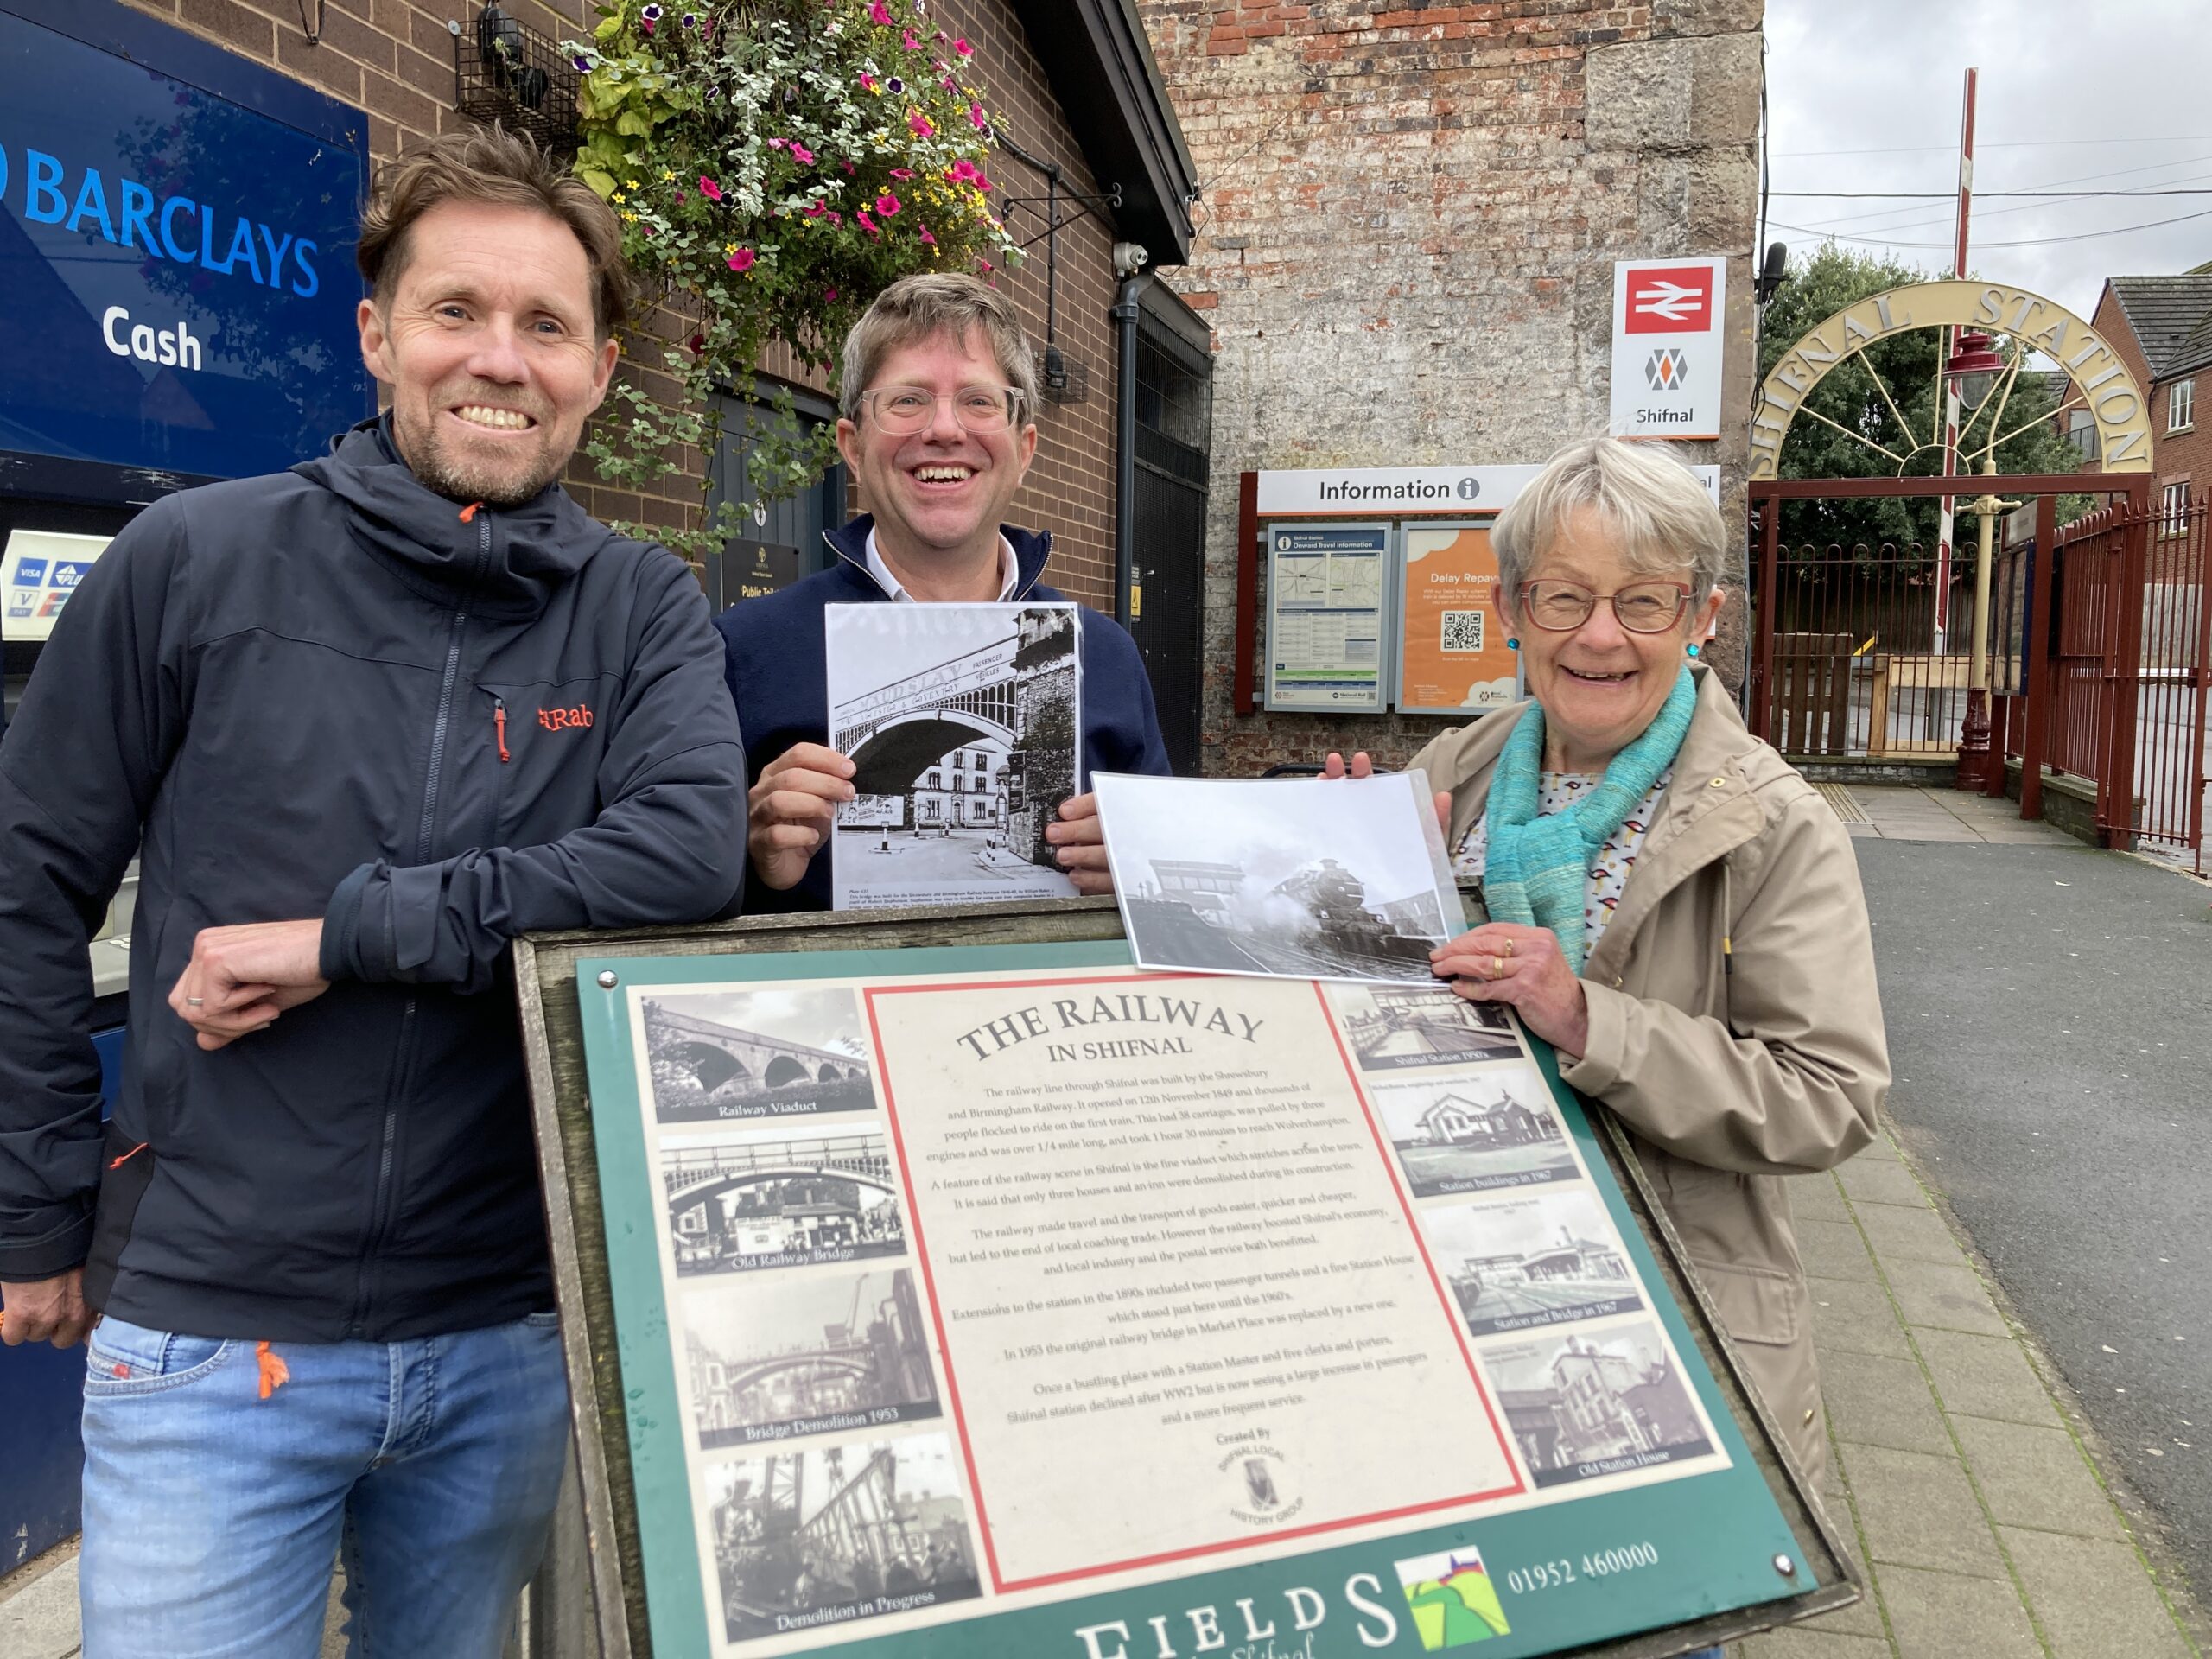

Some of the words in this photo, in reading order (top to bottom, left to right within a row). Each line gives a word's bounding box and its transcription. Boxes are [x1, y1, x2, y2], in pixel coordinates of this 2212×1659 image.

[25, 149, 319, 297] BARCLAYS
[103, 306, 201, 371] Cash
[1749, 295, 1912, 478] SHIFNAL
[1974, 289, 2149, 465] STATION
[1637, 408, 1694, 423] Shifnal
[1319, 480, 1450, 499] Information
[21, 569, 41, 578] VISA
[61, 575, 84, 585] PLU
[1430, 573, 1460, 584] Delay
[741, 585, 761, 597] Public
[973, 653, 1003, 669] PASSENGER
[860, 663, 963, 711] MAUDSLAY
[547, 704, 594, 731] Rab
[957, 1007, 1050, 1061] THE
[1051, 995, 1264, 1043] RAILWAY
[1046, 1043, 1077, 1062] IN
[1084, 1037, 1193, 1060] SHIFNAL
[1395, 1054, 1428, 1066] Shifnal
[1428, 1052, 1461, 1064] Station
[982, 1087, 1003, 1097] The
[1005, 1085, 1041, 1096] railway
[1043, 1084, 1063, 1093] line
[1064, 1080, 1103, 1092] through
[1103, 1077, 1139, 1089] Shifnal
[1160, 1074, 1183, 1084] built
[1183, 1073, 1196, 1084] by
[1198, 1071, 1213, 1082] the
[1213, 1069, 1268, 1080] Shrewsbury
[719, 1105, 767, 1116] Railway
[770, 1102, 817, 1113] Viaduct
[947, 1109, 967, 1120] and
[968, 1105, 1032, 1118] Birmingham
[1077, 1100, 1086, 1109] It
[1087, 1096, 1123, 1111] opened
[1138, 1094, 1160, 1104] 12th
[1160, 1090, 1210, 1103] November
[1211, 1088, 1233, 1099] 1849
[1234, 1087, 1253, 1096] and
[1253, 1083, 1300, 1095] thousands
[1300, 1082, 1311, 1091] of
[944, 1128, 978, 1143] people
[980, 1123, 1018, 1137] flocked
[1019, 1125, 1031, 1134] to
[1032, 1122, 1052, 1132] ride
[1069, 1119, 1085, 1129] the
[1086, 1118, 1108, 1128] first
[1135, 1113, 1158, 1123] This
[1157, 1111, 1178, 1122] had
[1178, 1110, 1191, 1120] 38
[1256, 1102, 1287, 1116] pulled
[1286, 1102, 1300, 1113] by
[1300, 1100, 1325, 1109] three
[925, 1150, 966, 1164] engines
[968, 1147, 988, 1158] and
[989, 1147, 1011, 1155] was
[1012, 1145, 1034, 1154] over
[1037, 1141, 1056, 1154] 1/4
[1058, 1139, 1080, 1150] mile
[1109, 1135, 1128, 1146] and
[1128, 1133, 1151, 1144] took
[1152, 1132, 1158, 1141] 1
[1159, 1131, 1183, 1141] hour
[1184, 1128, 1197, 1138] 30
[1198, 1127, 1236, 1137] minutes
[1248, 1122, 1274, 1133] reach
[931, 1179, 940, 1191] A
[942, 1179, 980, 1190] feature
[981, 1174, 992, 1185] of
[995, 1173, 1011, 1184] the
[1014, 1171, 1052, 1183] railway
[1053, 1169, 1081, 1179] scene
[1083, 1166, 1095, 1176] in
[1095, 1162, 1131, 1174] Shifnal
[1132, 1162, 1141, 1172] is
[1142, 1160, 1159, 1170] the
[1160, 1158, 1179, 1168] fine
[1180, 1154, 1217, 1166] viaduct
[1217, 1151, 1249, 1162] which
[1249, 1147, 1290, 1160] stretches
[1319, 1143, 1335, 1153] the
[953, 1198, 963, 1209] It
[964, 1198, 975, 1208] is
[976, 1194, 998, 1206] said
[1000, 1193, 1020, 1205] that
[1022, 1191, 1046, 1204] only
[1047, 1189, 1074, 1199] three
[1075, 1186, 1111, 1197] houses
[1112, 1181, 1132, 1193] and
[1166, 1179, 1191, 1187] were
[1192, 1170, 1248, 1185] demolished
[1249, 1169, 1282, 1179] during
[1281, 1167, 1294, 1176] its
[1439, 1181, 1474, 1192] Station
[1520, 1173, 1530, 1183] in
[732, 1255, 757, 1269] Old
[760, 1252, 810, 1267] Railway
[814, 1248, 854, 1261] Bridge
[1494, 1316, 1530, 1330] Station
[1531, 1313, 1550, 1325] and
[1550, 1308, 1583, 1321] Bridge
[1584, 1306, 1595, 1315] in
[745, 1424, 791, 1440] Bridge
[793, 1414, 867, 1433] Demolition
[869, 1407, 899, 1423] 1953
[1217, 1428, 1255, 1445] Created
[1256, 1427, 1270, 1440] By
[1578, 1461, 1599, 1477] Old
[1599, 1458, 1636, 1473] Station
[1636, 1452, 1669, 1465] House
[1230, 1507, 1274, 1525] HISTORY
[1507, 1559, 1577, 1594] 01952
[1582, 1541, 1659, 1578] 460000
[776, 1605, 855, 1630] Demolition
[859, 1600, 874, 1616] in
[875, 1591, 936, 1612] Progress
[1074, 1573, 1398, 1659] FIELDS
